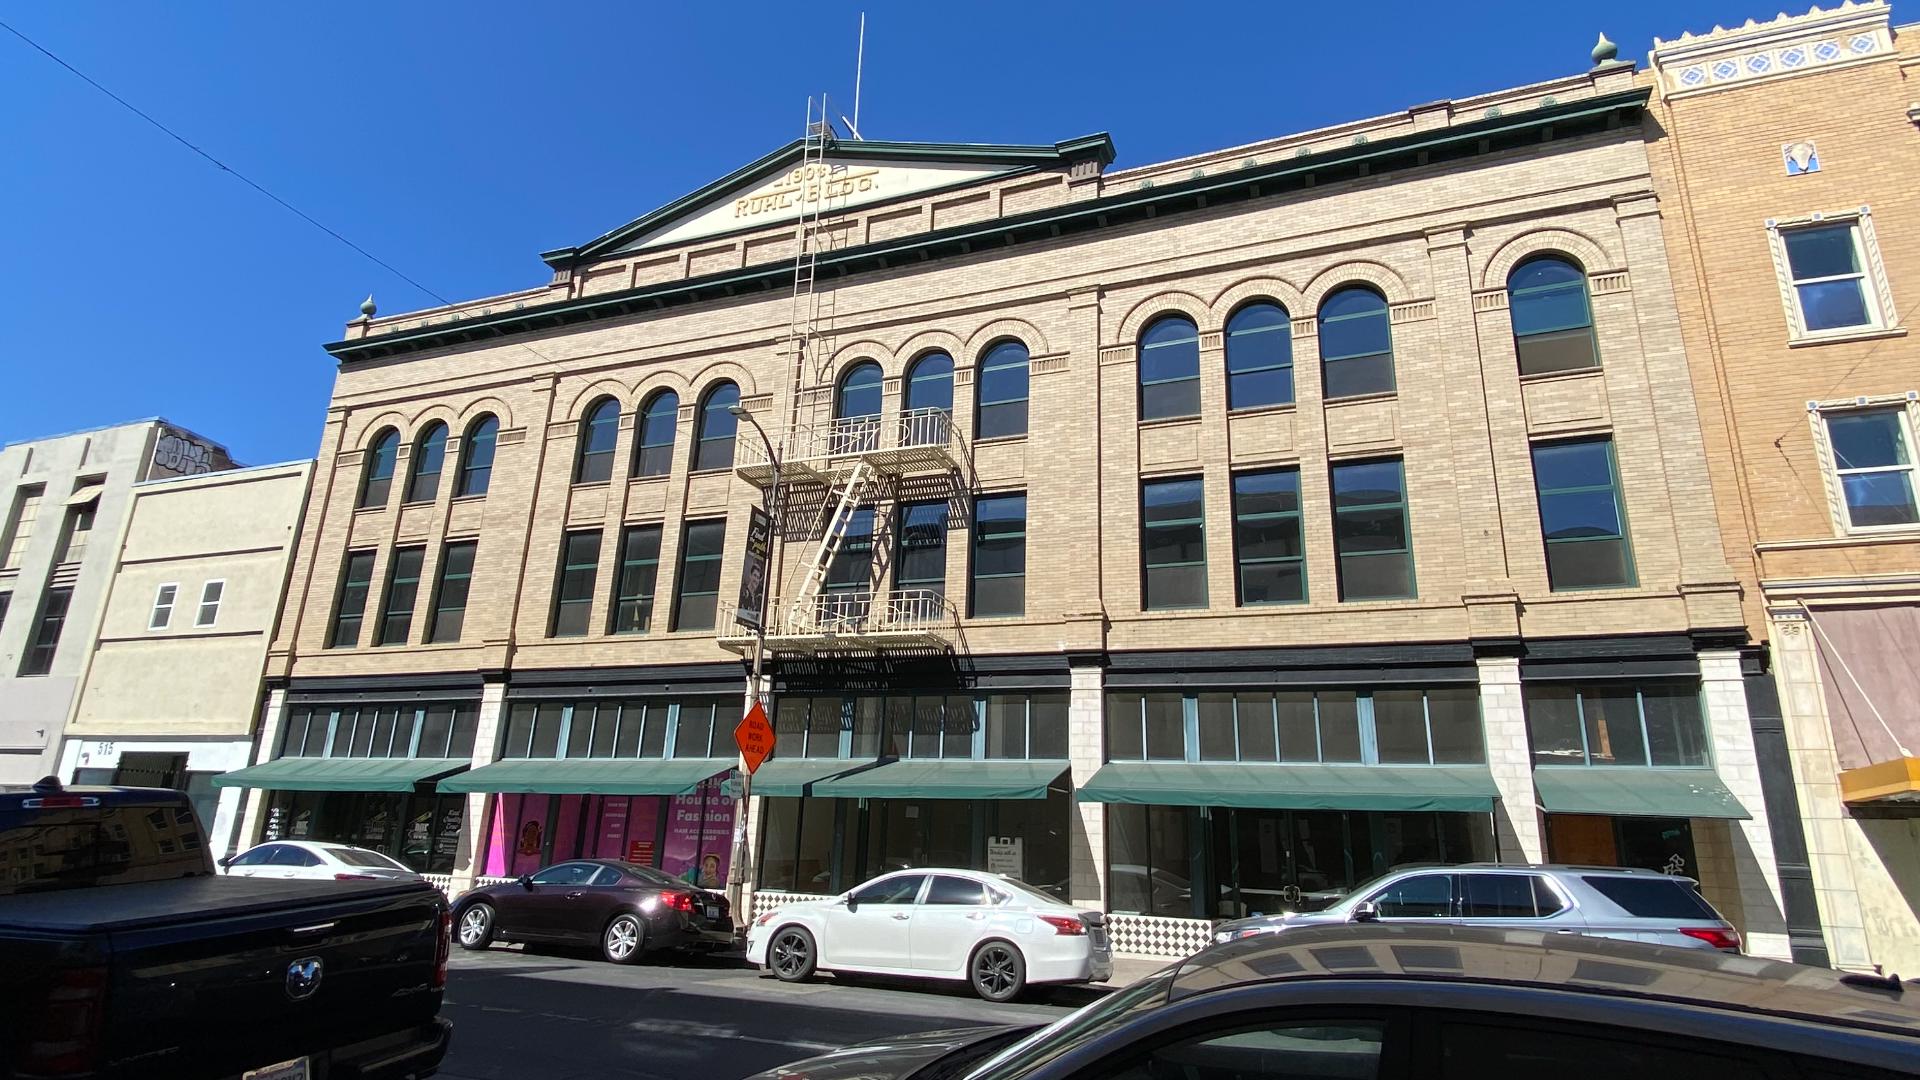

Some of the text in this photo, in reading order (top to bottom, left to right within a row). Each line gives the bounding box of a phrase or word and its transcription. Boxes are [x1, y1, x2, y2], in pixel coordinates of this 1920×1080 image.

[734, 195, 792, 218] RUHL
[749, 720, 764, 731] ROAD
[748, 733, 763, 742] WORK
[97, 742, 114, 755] 515
[745, 744, 764, 754] AHEAD
[675, 794, 719, 805] House
[676, 809, 730, 822] Fashion
